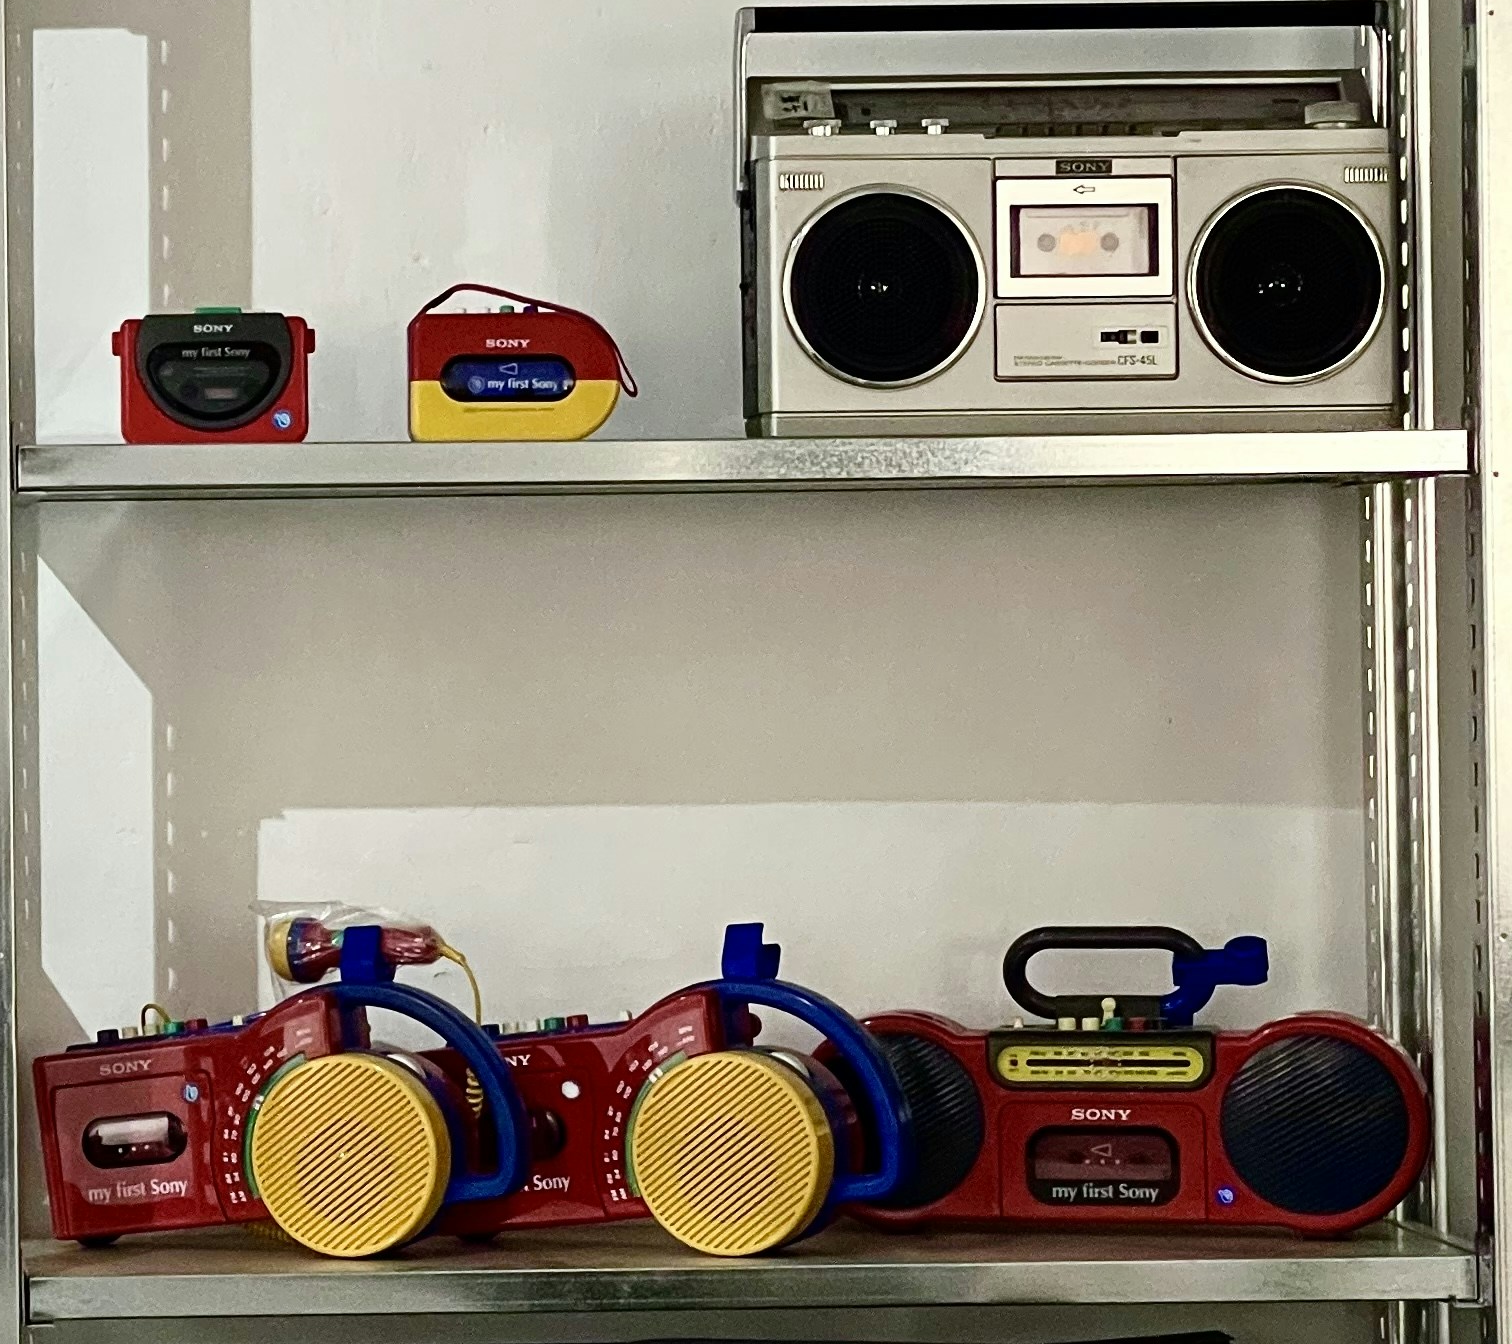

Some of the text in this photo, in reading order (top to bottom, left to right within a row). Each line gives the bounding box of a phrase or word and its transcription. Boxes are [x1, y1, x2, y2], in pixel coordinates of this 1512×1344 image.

[1059, 161, 1109, 173] SONY
[193, 324, 234, 333] SONY
[485, 339, 530, 348] SONY
[488, 378, 558, 391] my first Sony
[504, 1054, 531, 1067] NY
[99, 1059, 152, 1076] SONY
[1070, 1108, 1131, 1120] SONY
[532, 1174, 571, 1193] Sony
[88, 1178, 188, 1203] my first Sony
[1052, 1182, 1159, 1203] my first Sony
